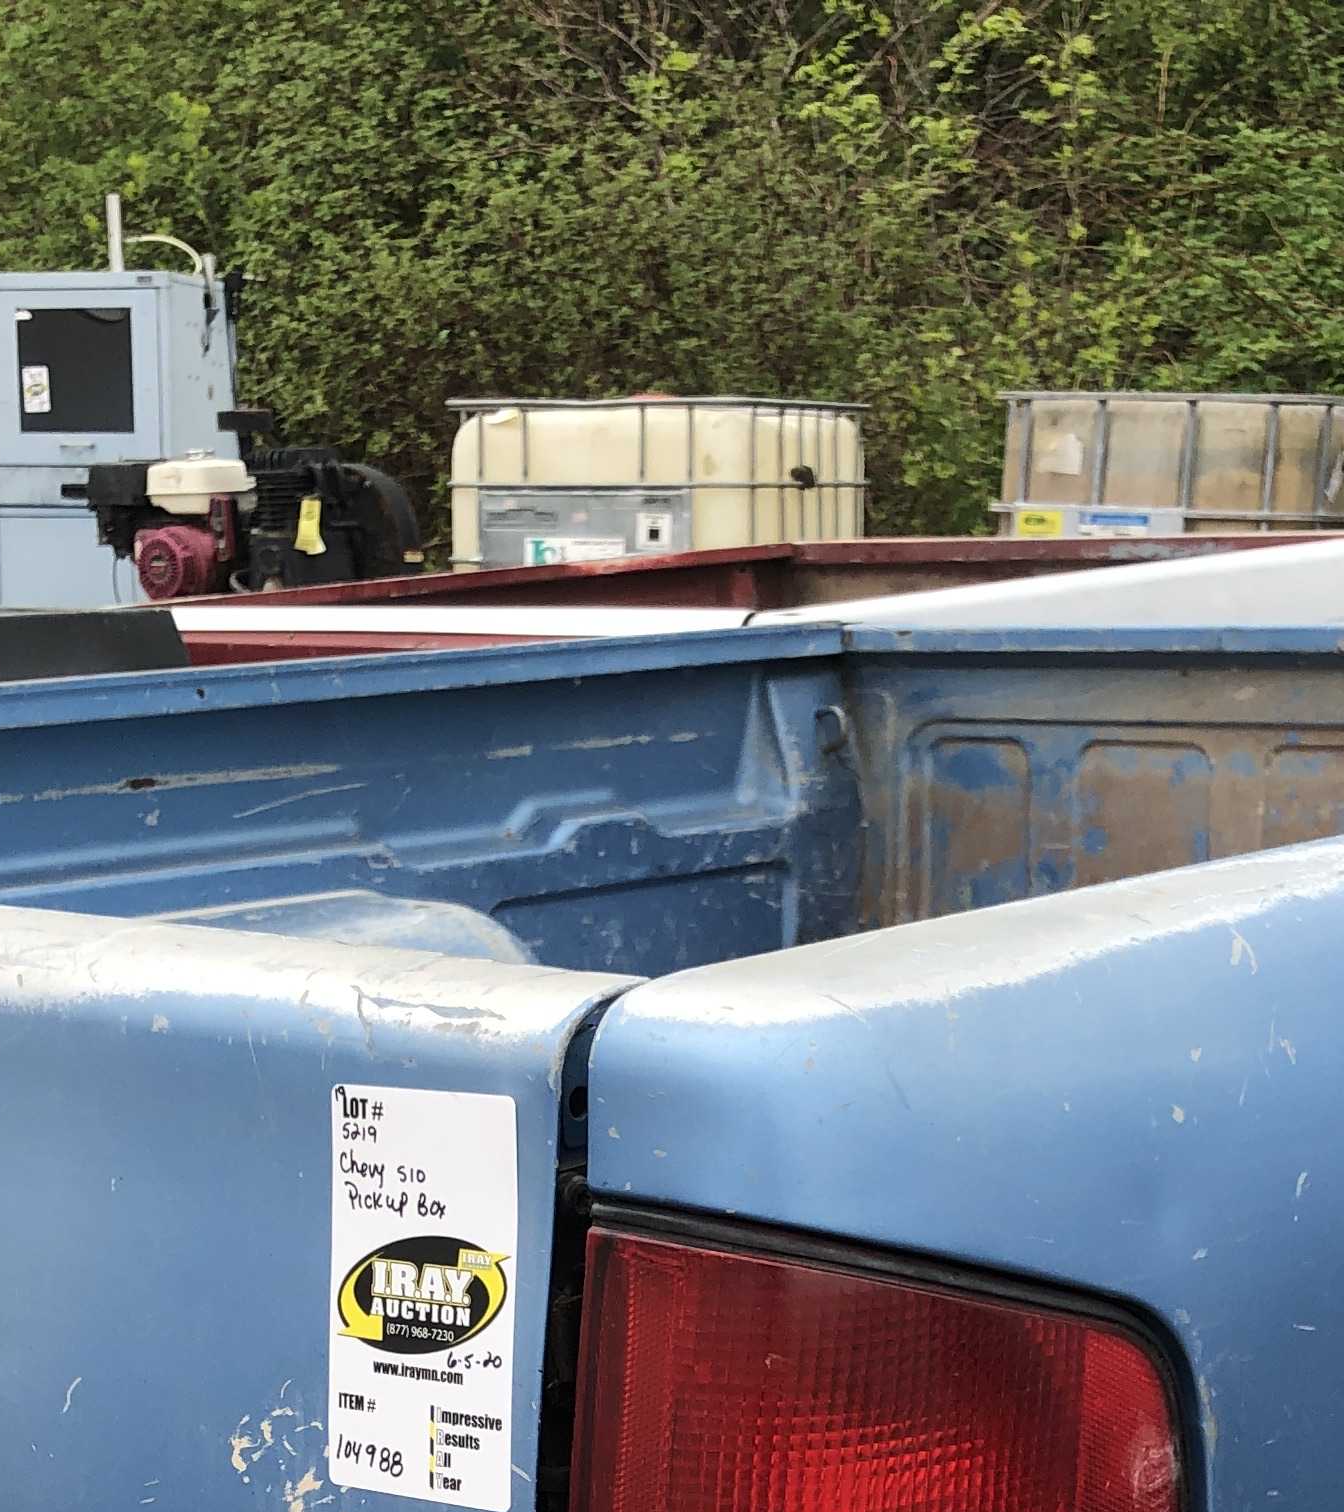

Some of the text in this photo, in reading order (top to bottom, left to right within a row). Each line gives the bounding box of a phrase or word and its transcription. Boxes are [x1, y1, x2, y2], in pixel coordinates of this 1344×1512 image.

[343, 1096, 369, 1120] LOT
[342, 1121, 377, 1144] 5219
[339, 1148, 426, 1189] Chevy S10
[417, 1192, 446, 1219] Box
[370, 1296, 472, 1328] AUCTION
[386, 1322, 455, 1343] (877) 968-7230
[373, 1360, 464, 1386] www.iraymn.com
[338, 1392, 365, 1412] ITEM
[436, 1406, 503, 1432] Impressive
[435, 1428, 481, 1451] Results
[336, 1433, 404, 1478] 104988
[435, 1450, 452, 1468] All
[435, 1472, 463, 1492] Year
